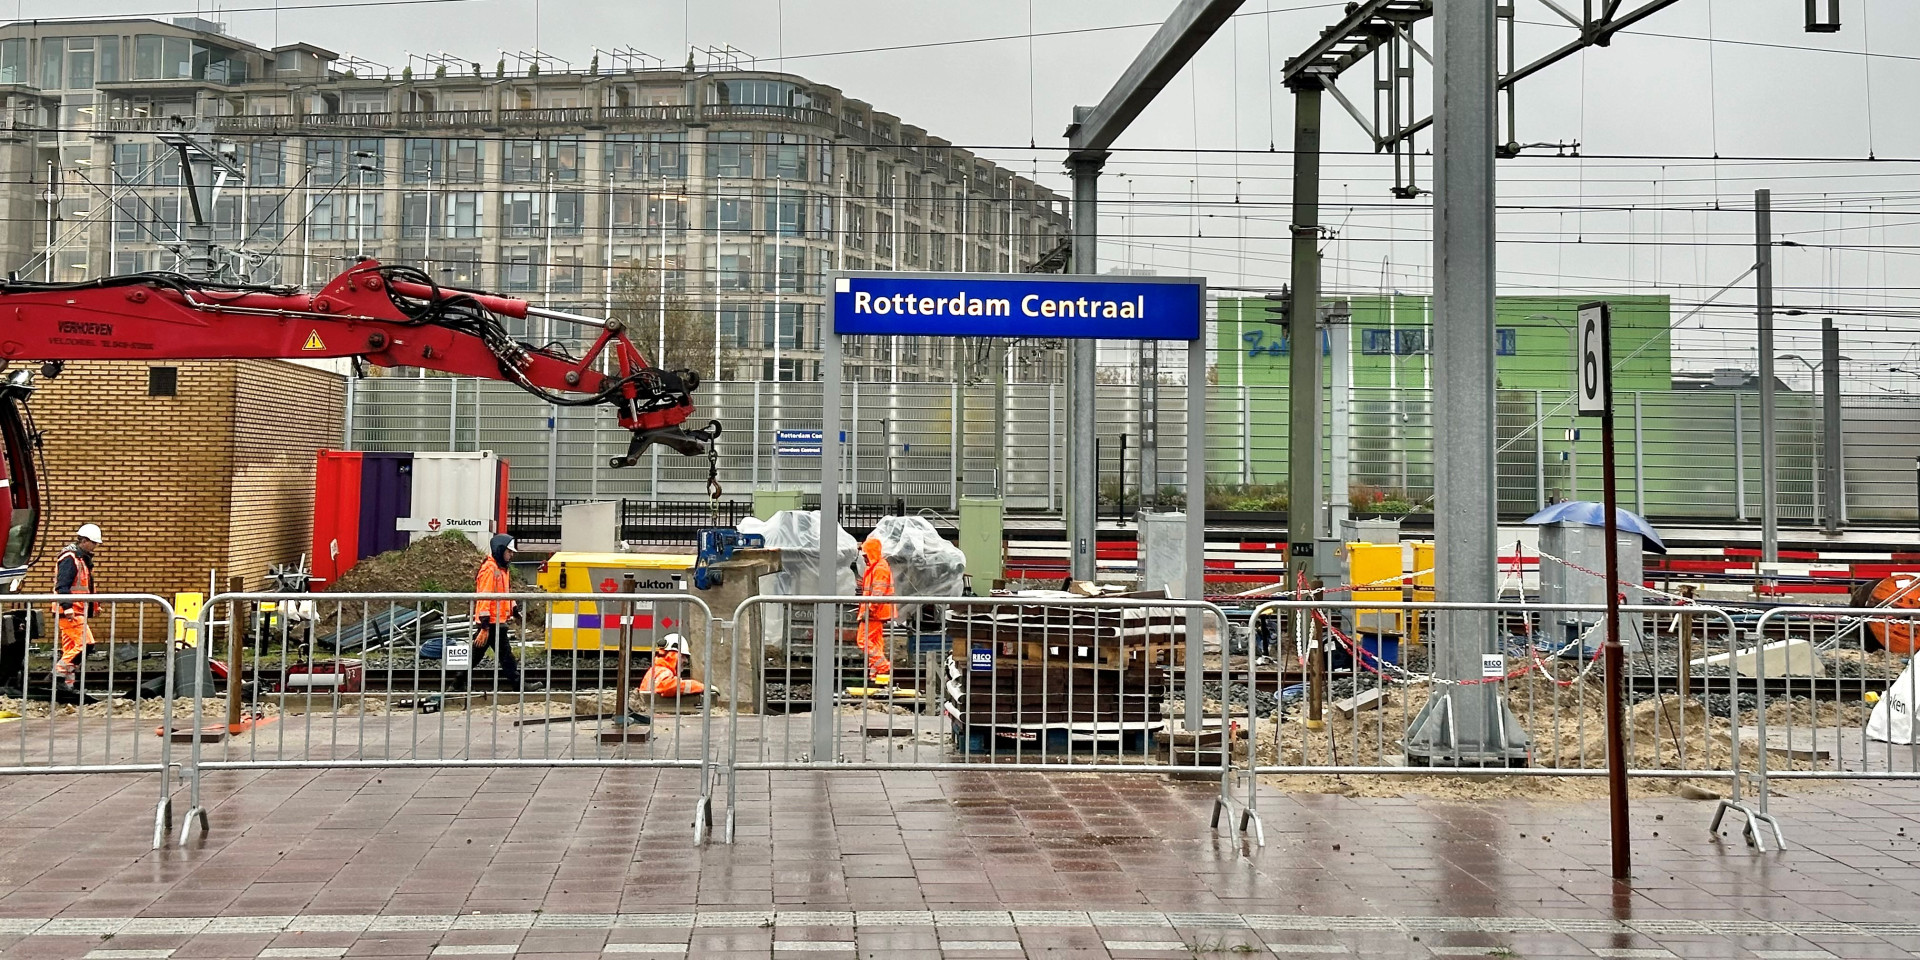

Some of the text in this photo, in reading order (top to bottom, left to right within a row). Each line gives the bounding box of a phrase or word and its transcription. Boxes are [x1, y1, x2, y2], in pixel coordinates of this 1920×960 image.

[854, 291, 1144, 319] Rotterdam Centraal
[58, 320, 113, 336] VERHOEVEN
[1584, 319, 1597, 400] 6
[446, 518, 482, 526] Strukton
[634, 580, 674, 590] rukton
